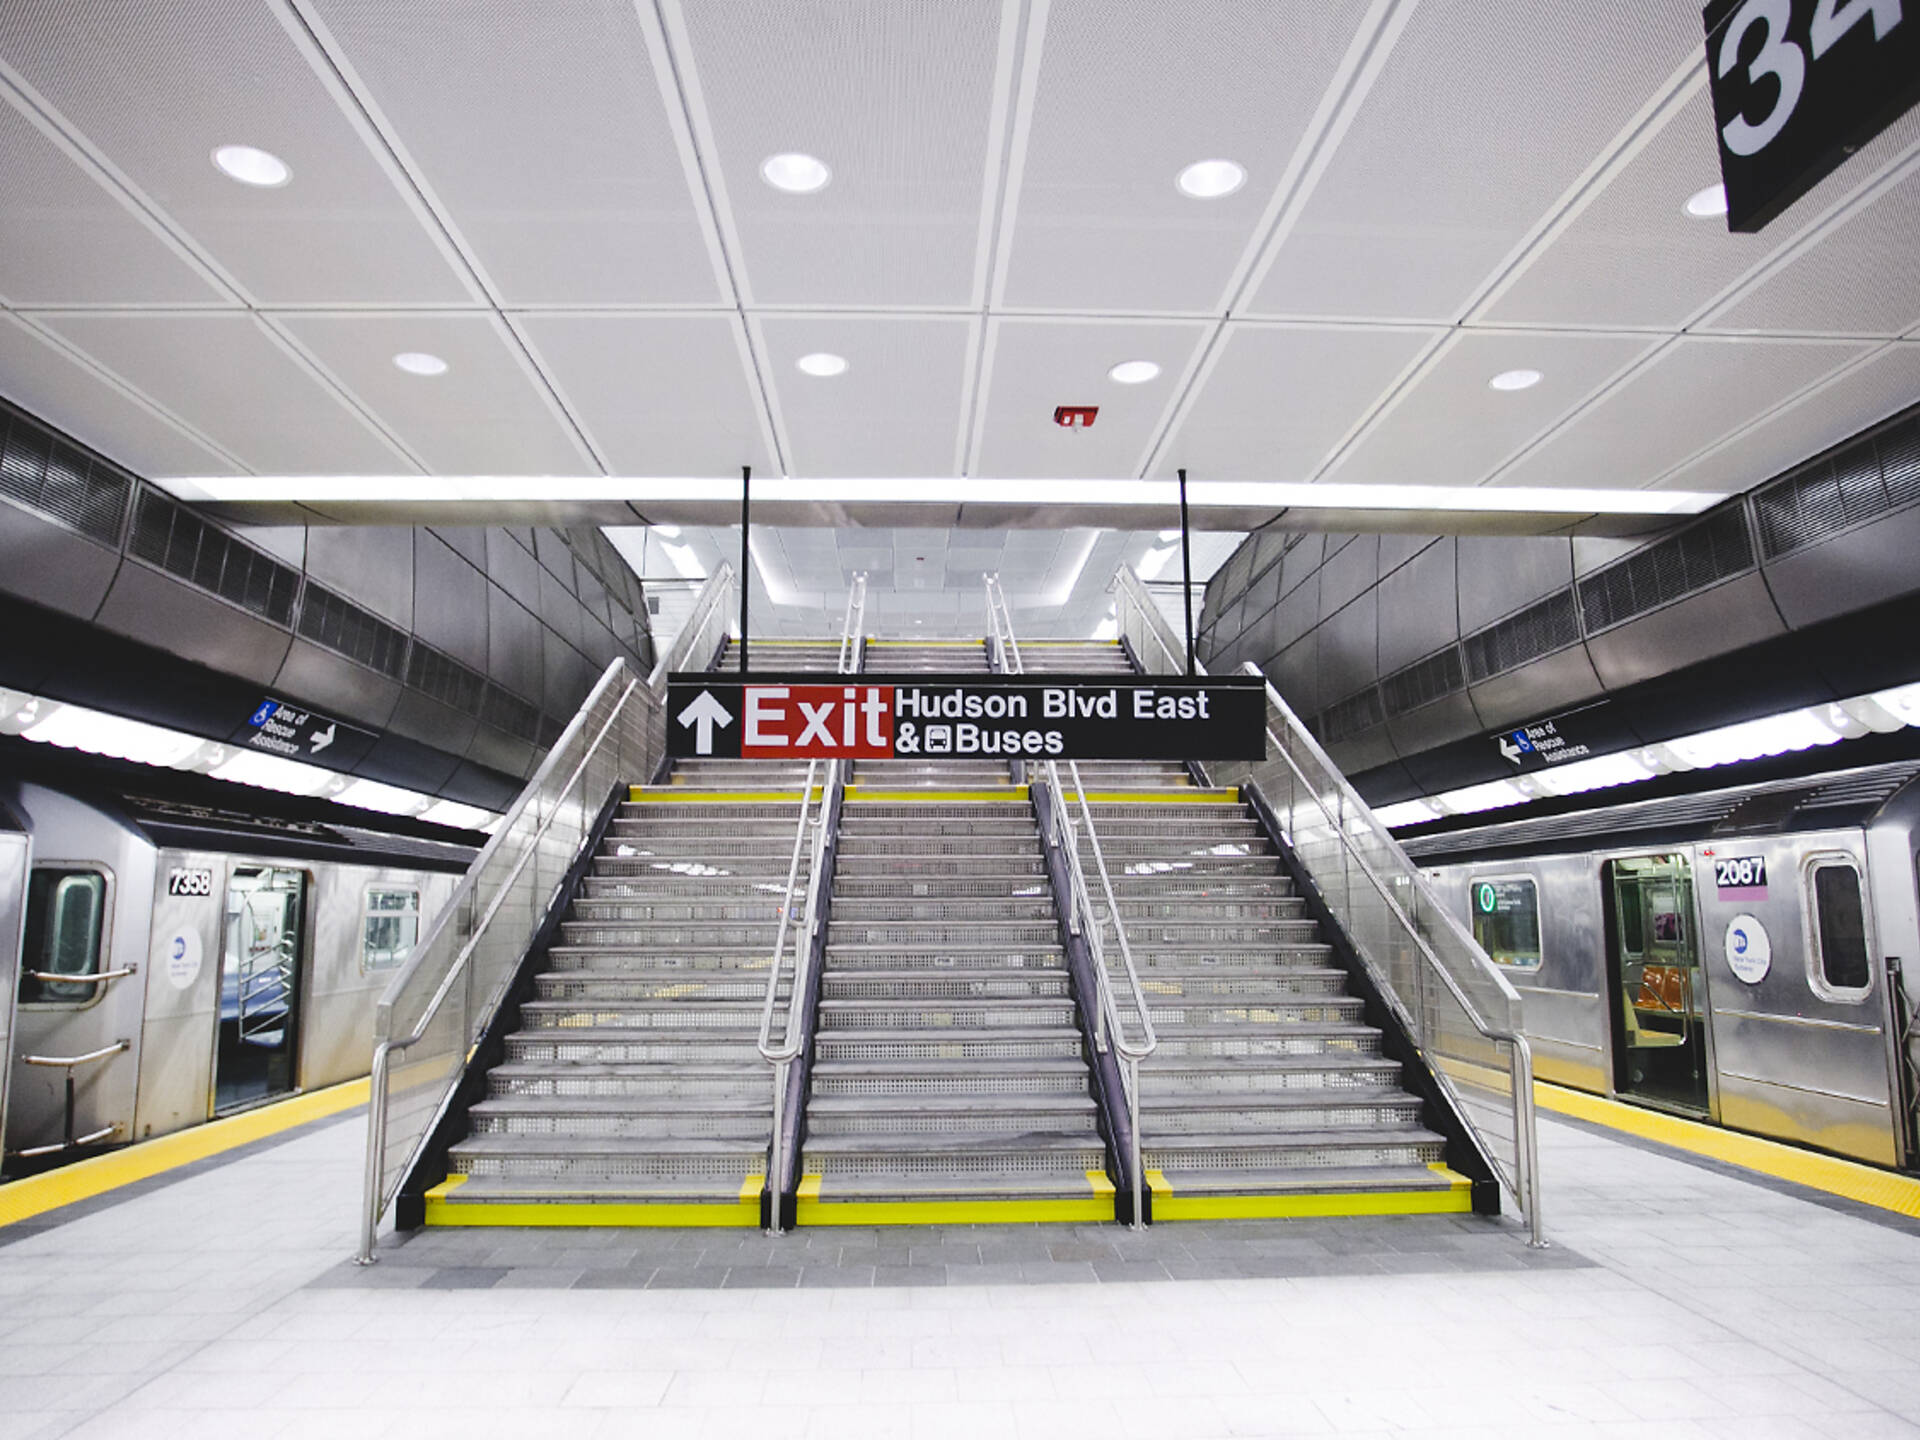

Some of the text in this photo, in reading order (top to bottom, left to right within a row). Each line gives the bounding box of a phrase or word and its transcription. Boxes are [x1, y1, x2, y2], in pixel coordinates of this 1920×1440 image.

[272, 704, 310, 726] Area of
[744, 687, 888, 747] Exit
[895, 688, 1210, 719] Hudson Blvd East
[260, 718, 296, 738] Rescue
[895, 722, 1064, 753] & Buses
[1525, 720, 1557, 740] Area of
[1531, 736, 1566, 752] Rescue
[171, 868, 211, 895] 7358
[1717, 857, 1763, 885] 2087
